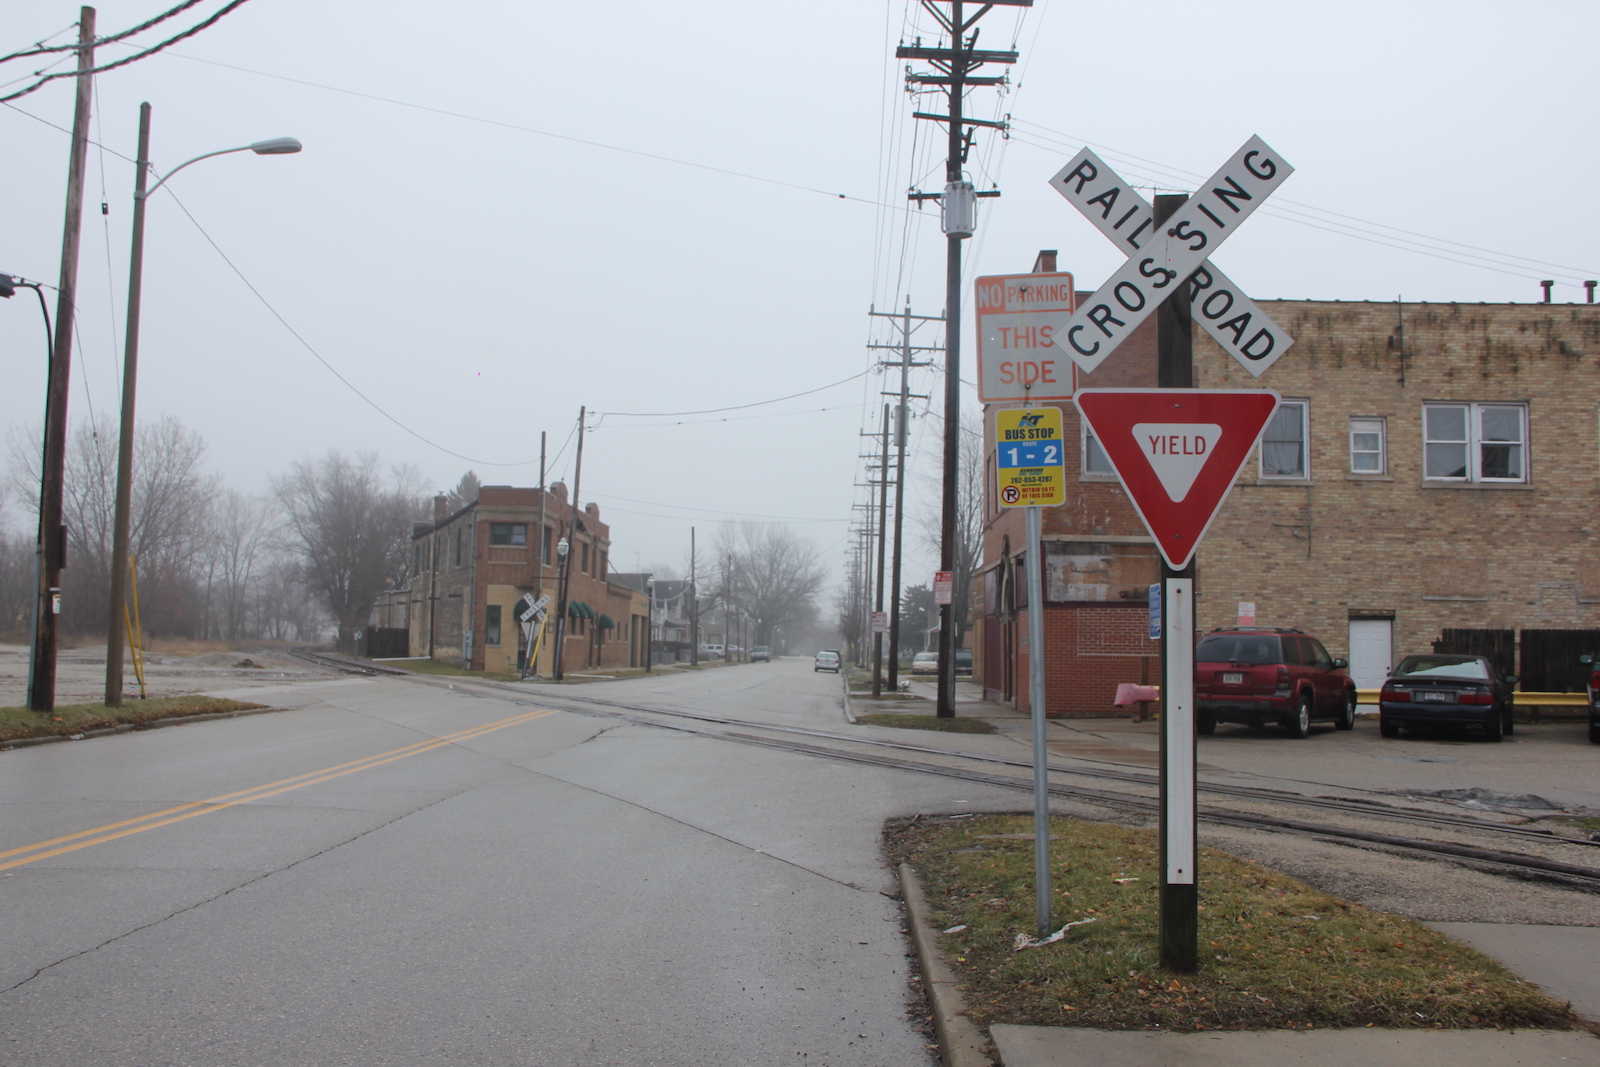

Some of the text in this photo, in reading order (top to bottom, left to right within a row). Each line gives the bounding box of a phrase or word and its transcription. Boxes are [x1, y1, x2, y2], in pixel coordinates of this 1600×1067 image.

[1067, 150, 1277, 357] CROSSING
[978, 284, 1068, 308] NO PARKING
[997, 325, 1055, 350] THIS
[999, 360, 1057, 384] SIDE
[1005, 428, 1054, 440] BUS STOP
[1148, 435, 1206, 455] YIELD
[1007, 447, 1018, 466] 1
[1043, 445, 1058, 464] 2
[1010, 476, 1053, 484] 262-653-4287
[522, 595, 549, 620] CROSSING
